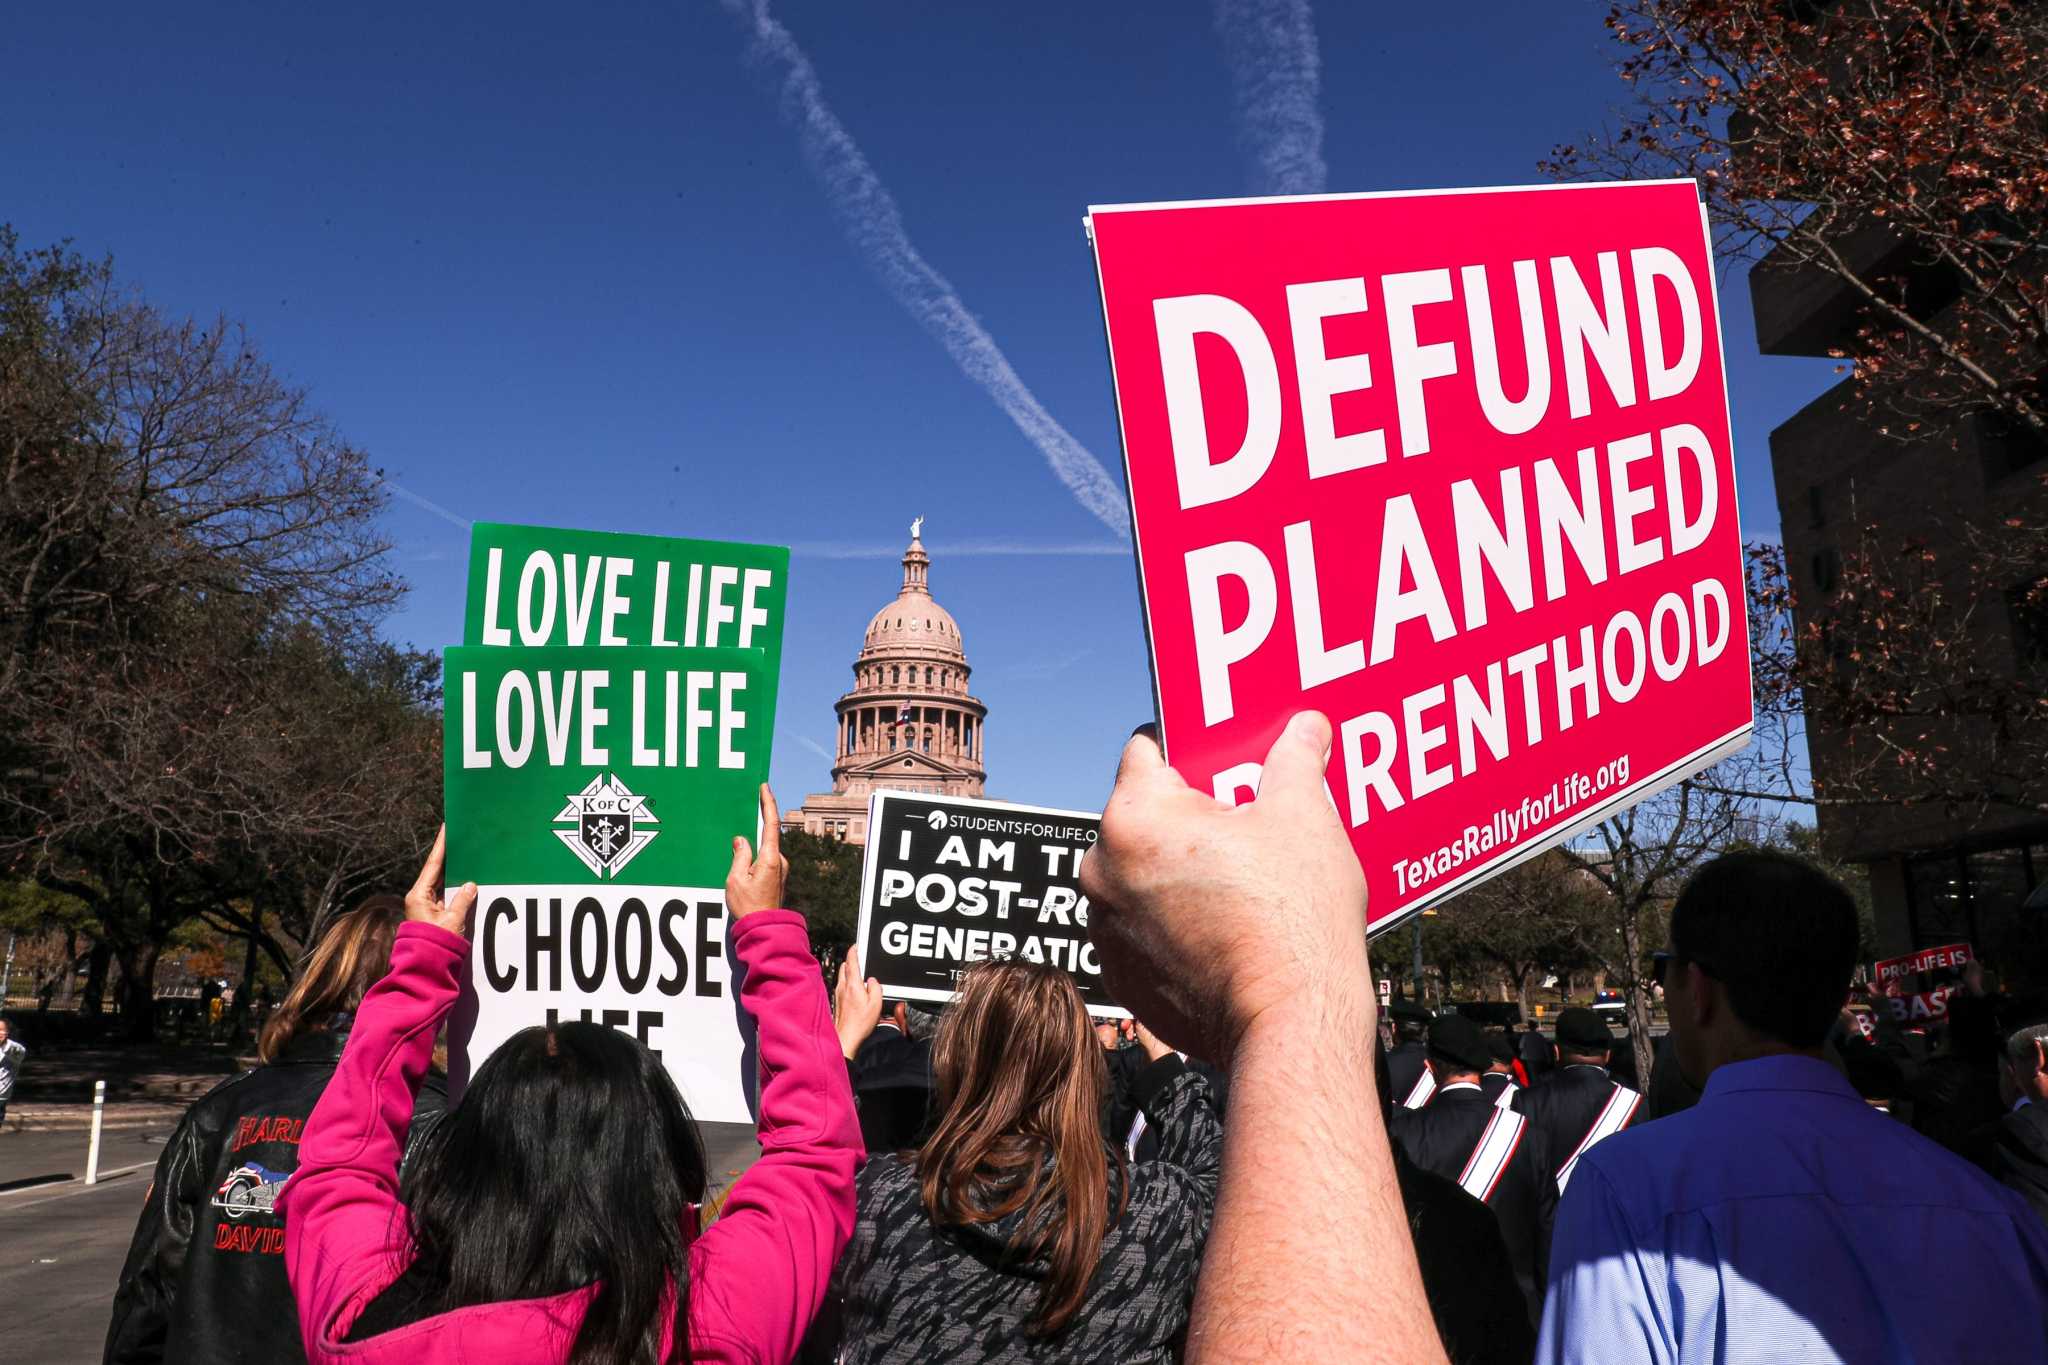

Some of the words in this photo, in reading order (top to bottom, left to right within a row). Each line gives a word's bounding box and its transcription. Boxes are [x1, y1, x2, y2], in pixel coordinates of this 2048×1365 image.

[1153, 247, 1703, 511] DEFUND
[482, 548, 634, 647] LOVE
[1184, 423, 1718, 728] PLANNED
[462, 669, 610, 769] LOVE
[631, 669, 747, 769] LIFE
[1213, 577, 1731, 829] RENTHOOD
[582, 797, 596, 813] K
[598, 800, 615, 810] OF
[617, 797, 631, 813] C
[898, 829, 912, 861] I
[935, 835, 1016, 872] AM
[1392, 754, 1630, 896] TexasRallyforLife.org
[482, 896, 723, 998] CHOOSE
[1880, 953, 1948, 979] PRO-LIFE
[1950, 950, 1968, 967] IS
